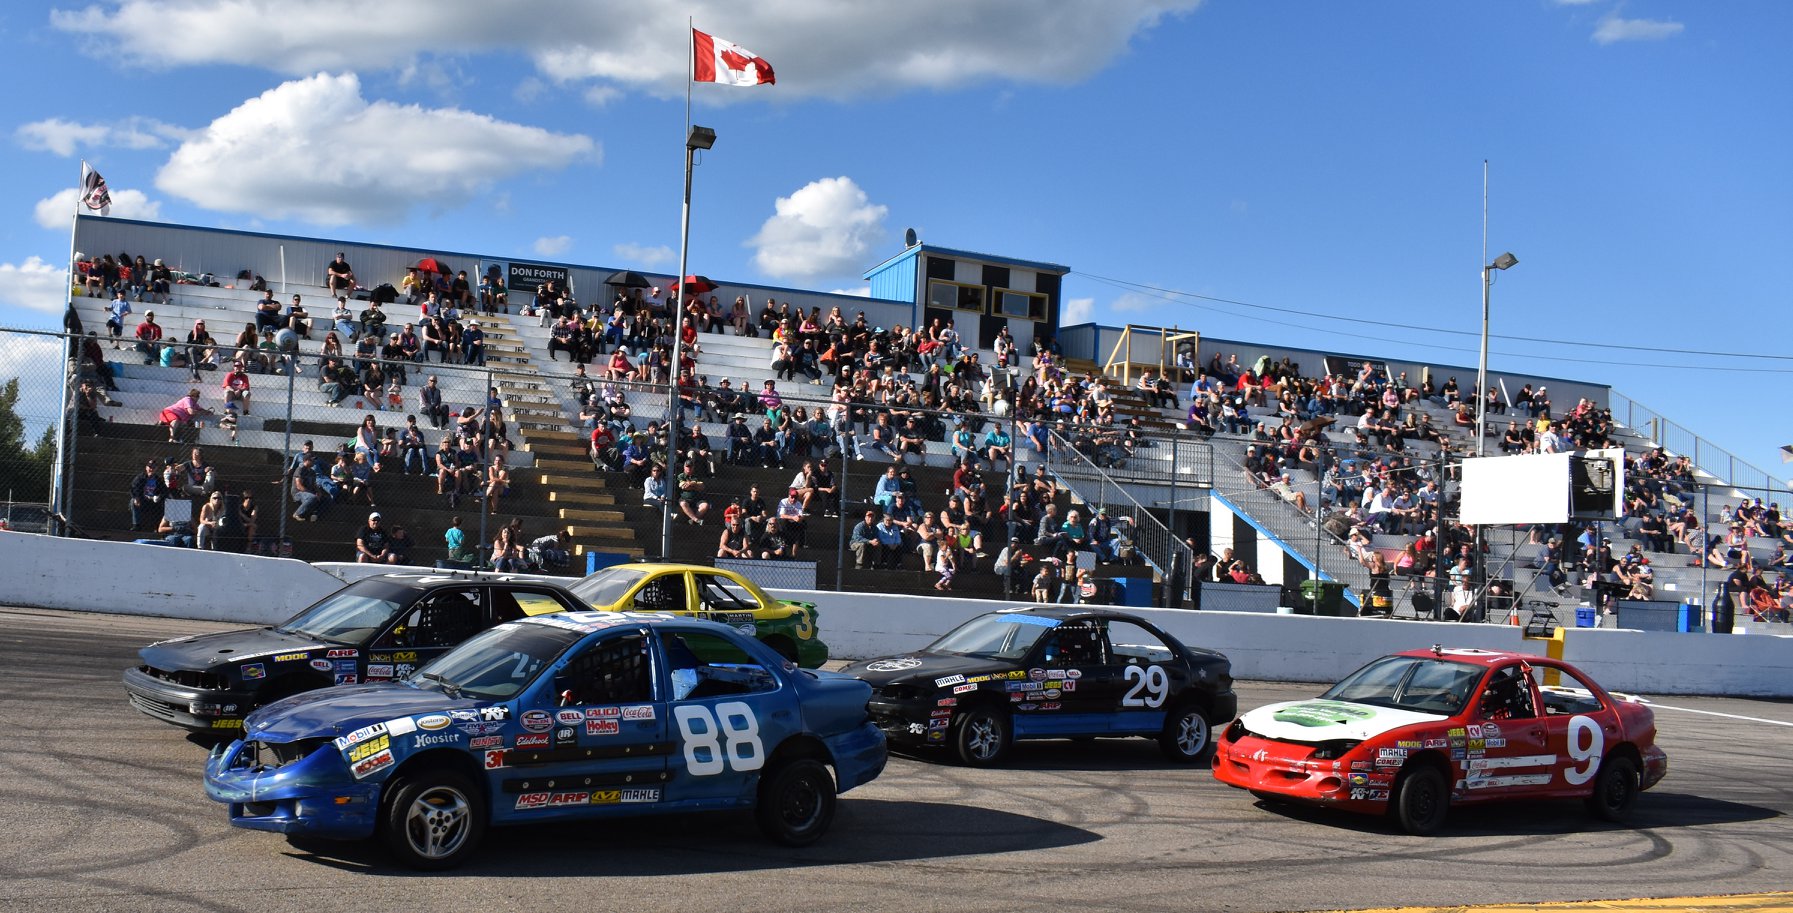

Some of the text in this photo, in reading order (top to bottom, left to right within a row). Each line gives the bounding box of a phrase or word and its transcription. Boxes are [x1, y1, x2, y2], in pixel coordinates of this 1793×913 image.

[511, 267, 565, 280] DON FORTH
[506, 394, 523, 402] ROW
[513, 407, 530, 415] ROW
[790, 607, 813, 640] 3
[274, 652, 308, 662] MOOG
[328, 649, 358, 657] ARP
[936, 674, 965, 686] MAHLE
[967, 675, 991, 683] MOOG
[954, 684, 972, 692] COMP
[1045, 681, 1062, 689] JEGS
[1063, 681, 1074, 690] CV
[1122, 664, 1169, 708] 29
[480, 706, 509, 721] K&N
[560, 712, 581, 720] BELL
[586, 707, 619, 717] CALICO
[212, 719, 243, 728] JEGS
[586, 720, 618, 733] Holley
[338, 726, 371, 747] Mobil
[1448, 728, 1466, 737] JEGS
[1469, 726, 1480, 737] CV
[413, 732, 460, 748] Hoosier
[516, 736, 550, 746] Edelbrock
[674, 701, 765, 776] 88
[1425, 739, 1446, 747] ARP
[348, 734, 390, 762] JEGS
[1380, 749, 1407, 757] MAHLE
[1564, 714, 1604, 786] 9
[518, 793, 549, 804] MSD
[551, 792, 589, 803] ARP
[622, 789, 660, 800] MAHLE
